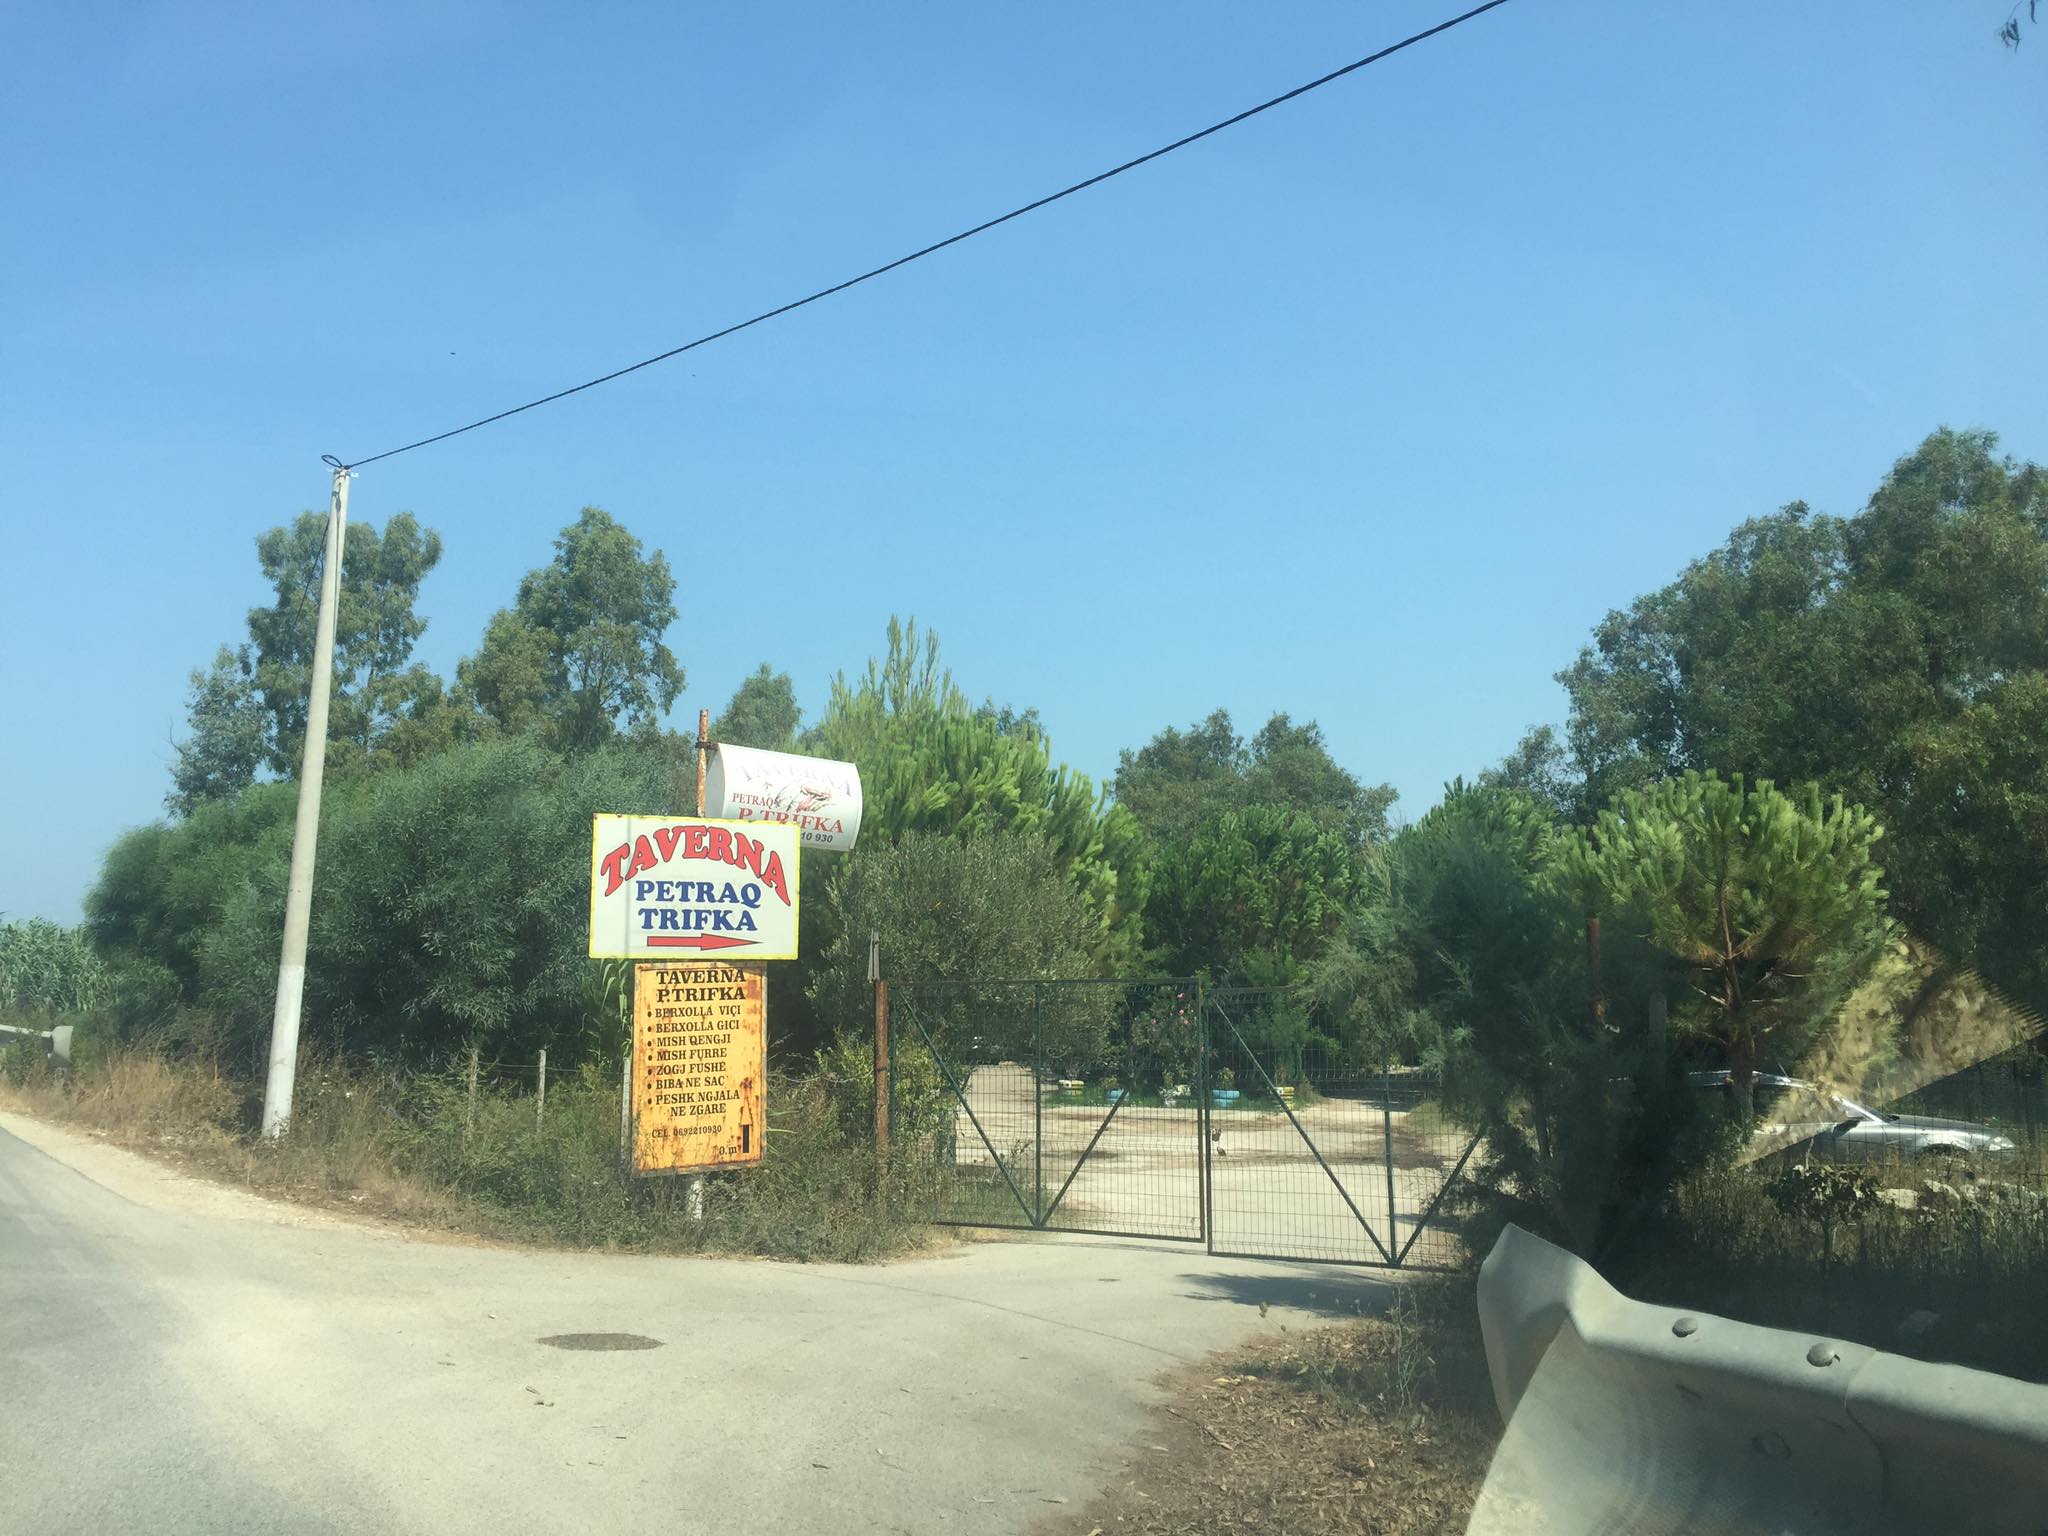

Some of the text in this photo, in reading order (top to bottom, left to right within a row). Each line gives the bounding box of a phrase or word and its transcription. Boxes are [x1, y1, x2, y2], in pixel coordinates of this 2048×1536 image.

[732, 792, 774, 809] PETRAQ
[760, 810, 843, 833] TRIFKA
[815, 833, 833, 843] 930
[601, 825, 791, 906] TAVERNA
[635, 880, 762, 909] PETRAQ
[638, 908, 758, 931] TRIFKA
[656, 970, 746, 985] TAVERNA
[655, 1006, 713, 1018] BERXOLLA
[656, 1020, 740, 1033] BERXOLLA GICI
[657, 1034, 731, 1047] MISH QENGJI
[657, 1048, 728, 1061] MISH FURRE
[656, 1064, 686, 1076] ZOGJ
[656, 1076, 725, 1090] BIBA NE SAC
[656, 1089, 740, 1105] PESHK NGJALA
[670, 1103, 727, 1117] NE ZGARE
